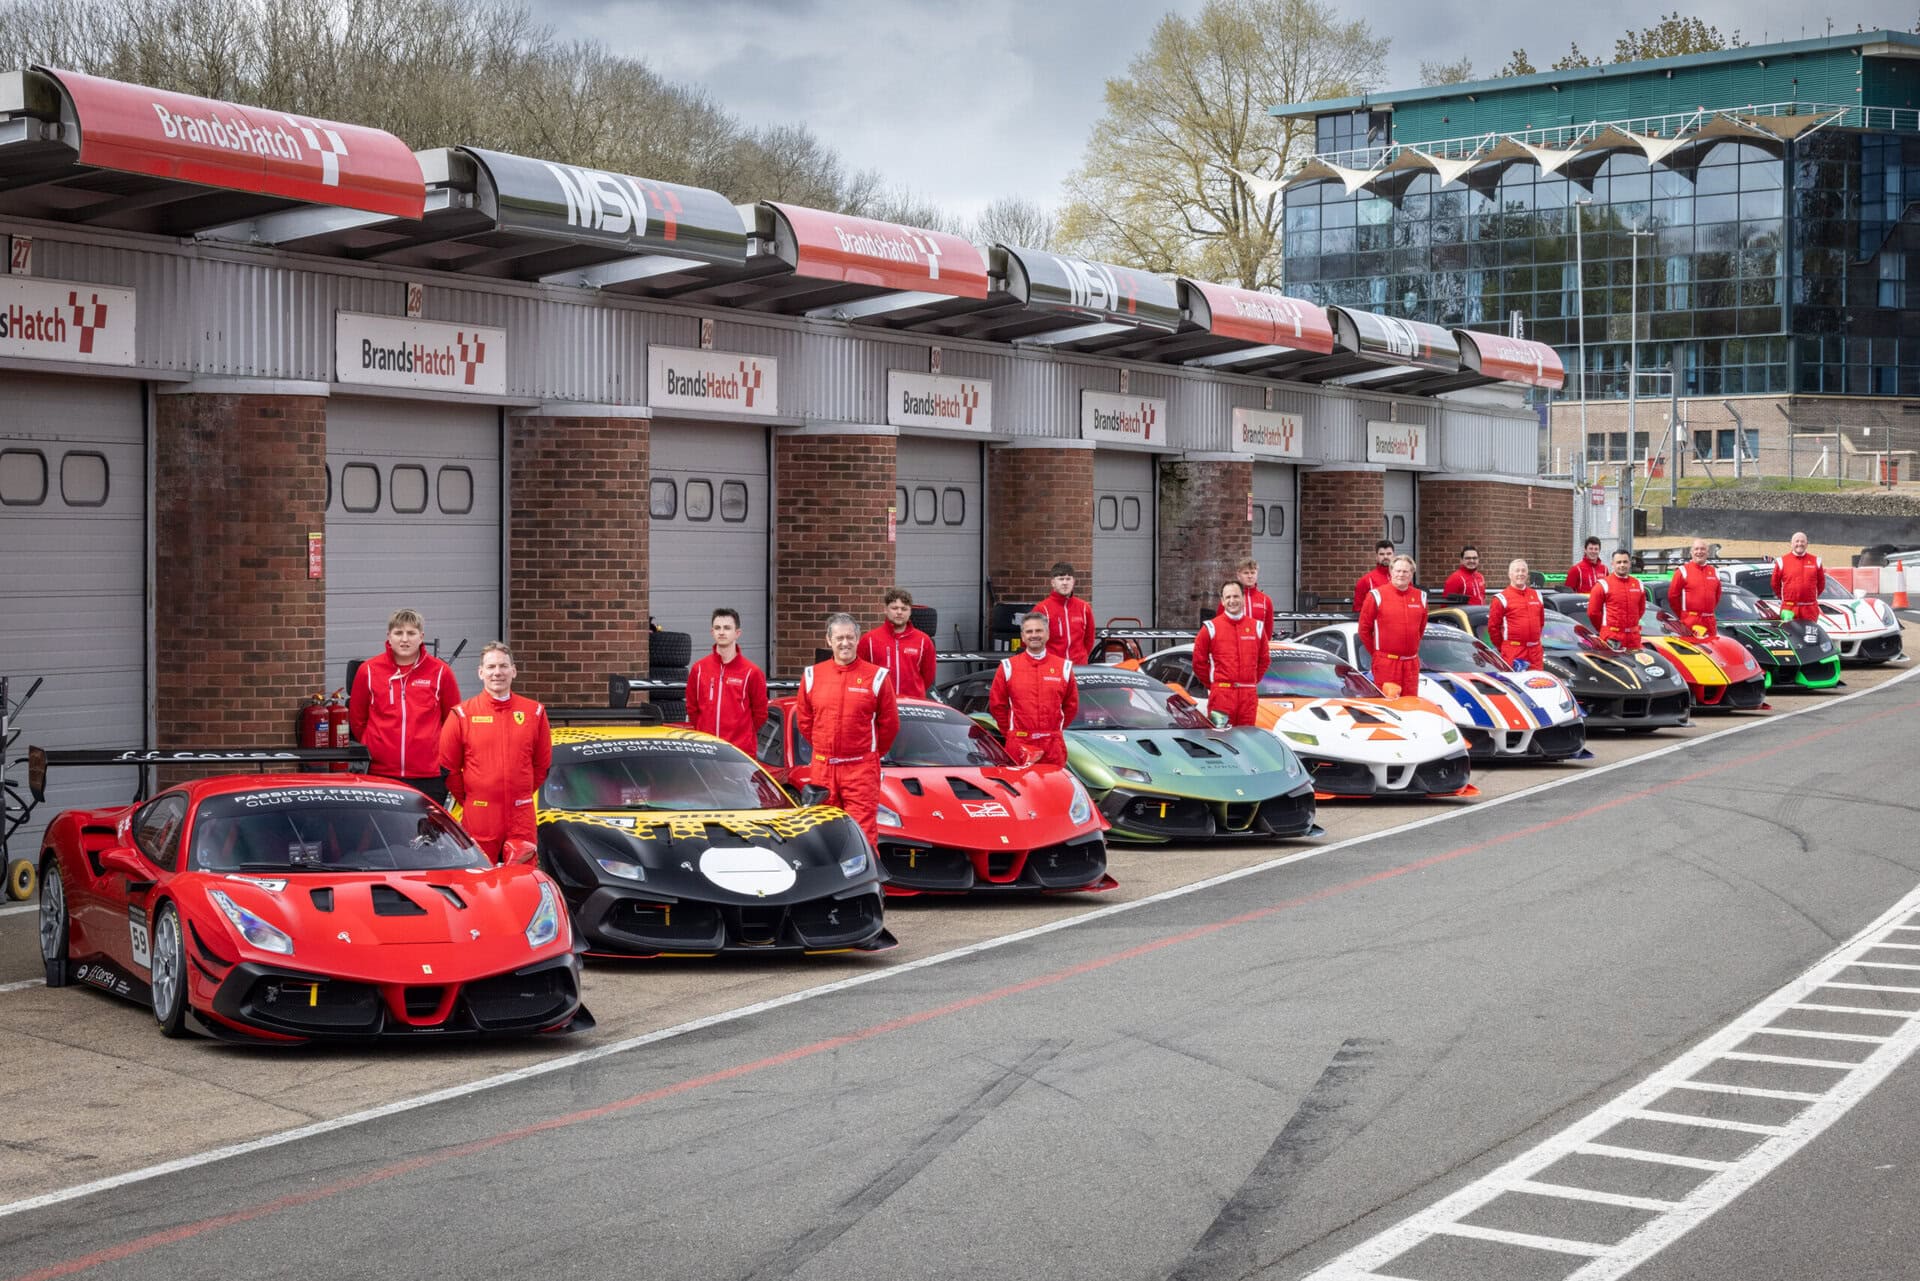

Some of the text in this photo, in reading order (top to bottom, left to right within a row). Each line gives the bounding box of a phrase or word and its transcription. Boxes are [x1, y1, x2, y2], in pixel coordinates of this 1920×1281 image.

[152, 103, 303, 161] BrandsHatch
[543, 163, 648, 237] MSV
[12, 240, 32, 269] 27
[834, 225, 918, 263] BrandsHatch
[1052, 256, 1119, 312] MSV
[408, 287, 422, 312] 28
[0, 304, 67, 343] sHatch
[703, 322, 713, 344] 29
[362, 339, 456, 376] BrandsHatch
[668, 368, 739, 400] BrandsHatch
[903, 390, 961, 418] BrandsHatch
[1094, 408, 1141, 433] BrandsHatch
[1243, 424, 1282, 446] BrandsHatch
[897, 706, 946, 715] ERRARI
[572, 740, 718, 752] PASSIONE FERRARI
[583, 744, 717, 756] CLUB CHALLENGE
[235, 789, 405, 803] PASSIONE FERRARI
[246, 794, 402, 808] CLUB CHALLENGE
[132, 926, 147, 955] 59
